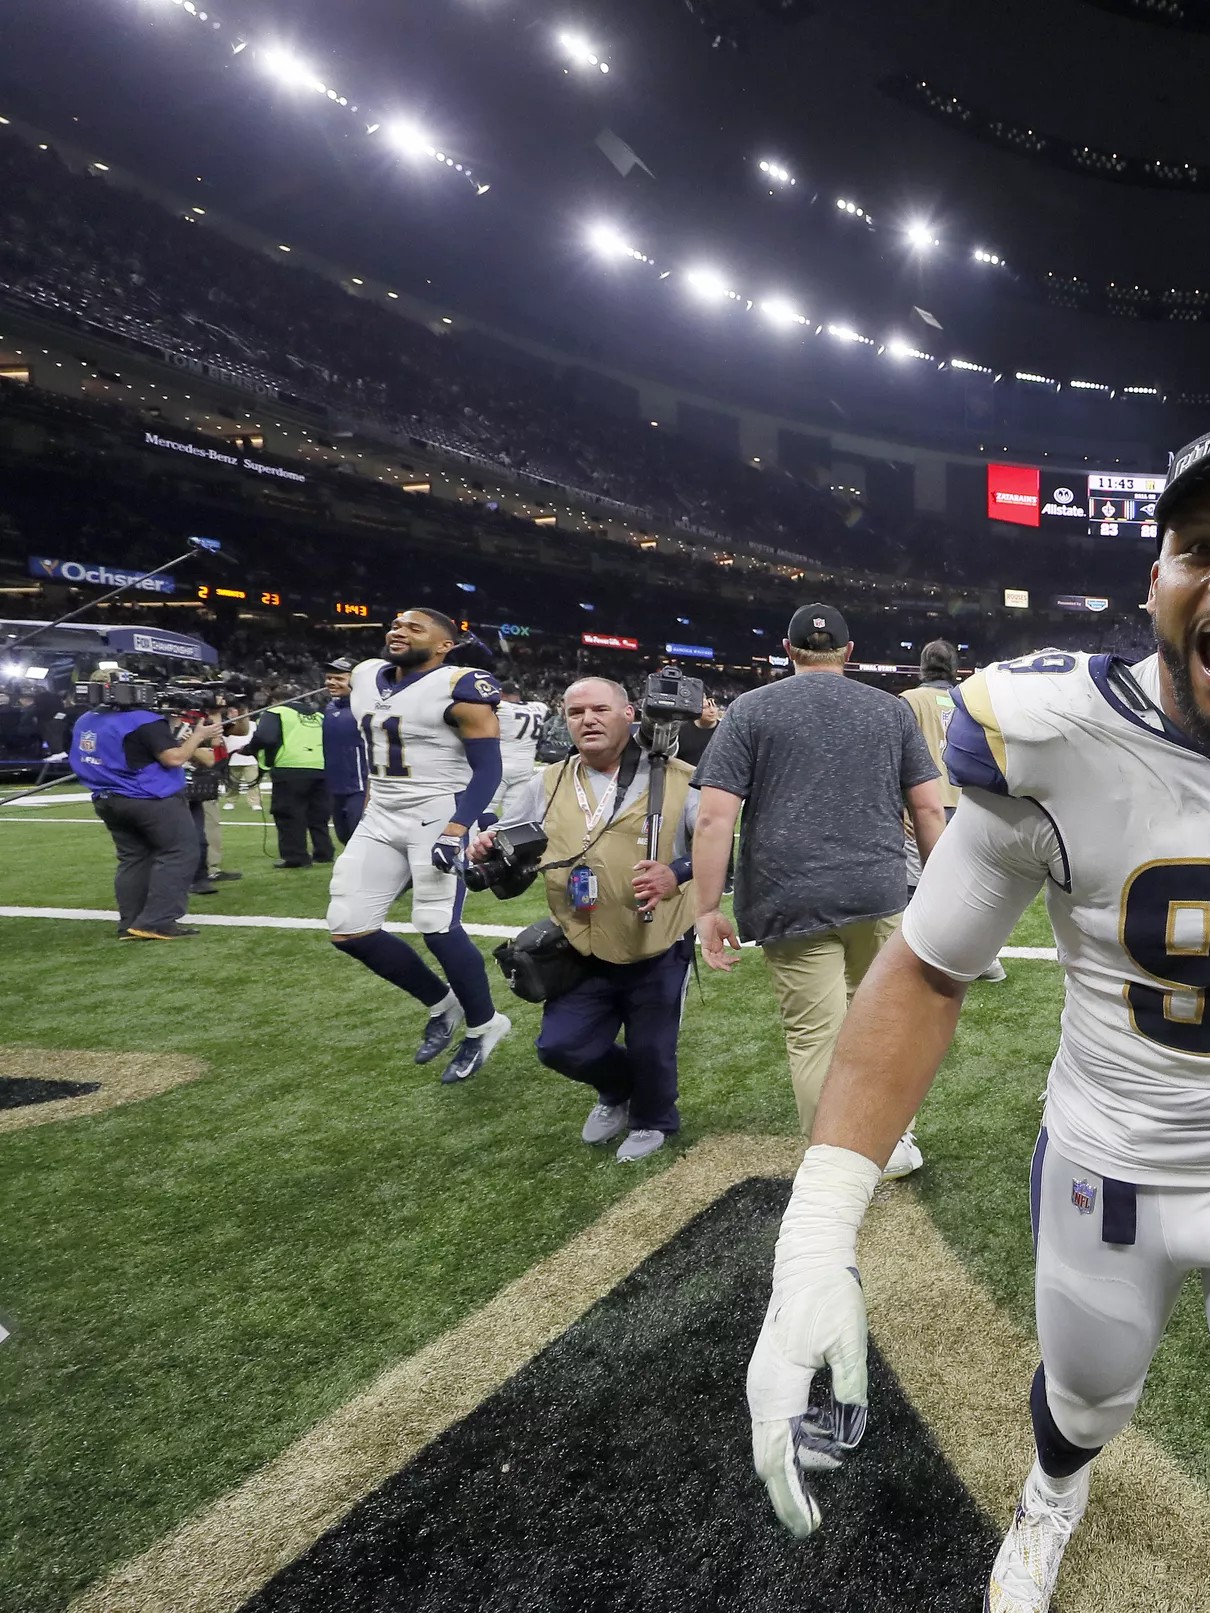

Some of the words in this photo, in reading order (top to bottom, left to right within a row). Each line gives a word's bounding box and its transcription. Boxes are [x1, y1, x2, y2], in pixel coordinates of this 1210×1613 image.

[144, 432, 238, 466] Mercedes-Benz
[243, 458, 306, 482] Superdome
[1099, 477, 1134, 489] 11:43
[60, 560, 164, 592] Ochsner
[261, 592, 281, 606] 23
[515, 712, 544, 740] 76
[360, 711, 413, 779] 11
[1074, 1191, 1090, 1209] NFL
